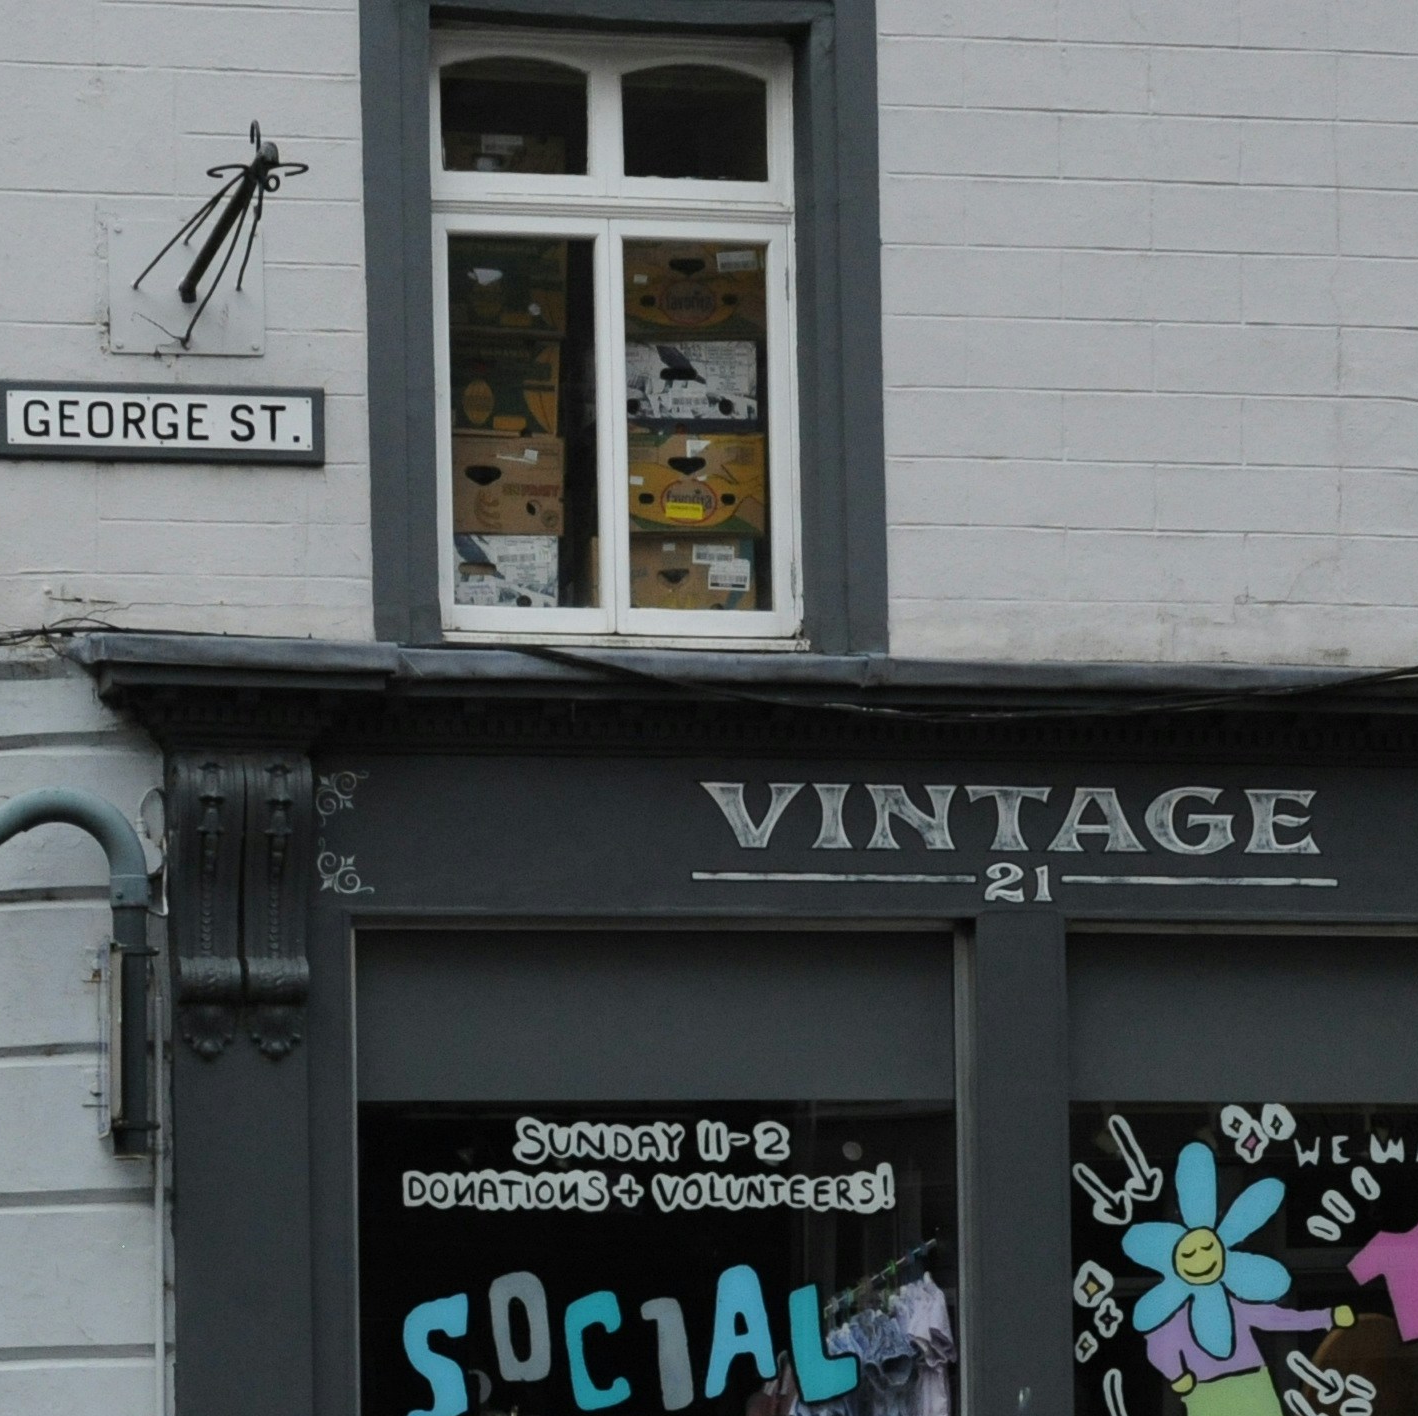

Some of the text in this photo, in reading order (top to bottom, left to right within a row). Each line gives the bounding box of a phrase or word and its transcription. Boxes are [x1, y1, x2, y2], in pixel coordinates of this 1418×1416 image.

[22, 400, 302, 445] GEORGE ST.
[699, 781, 1322, 856] VINTAGE
[983, 861, 1053, 902] 21
[515, 1119, 684, 1163] SUNDAY
[1294, 1135, 1351, 1167] WE
[405, 1171, 608, 1210] DONATIONS
[653, 1164, 896, 1212] VOLUNTEERS!
